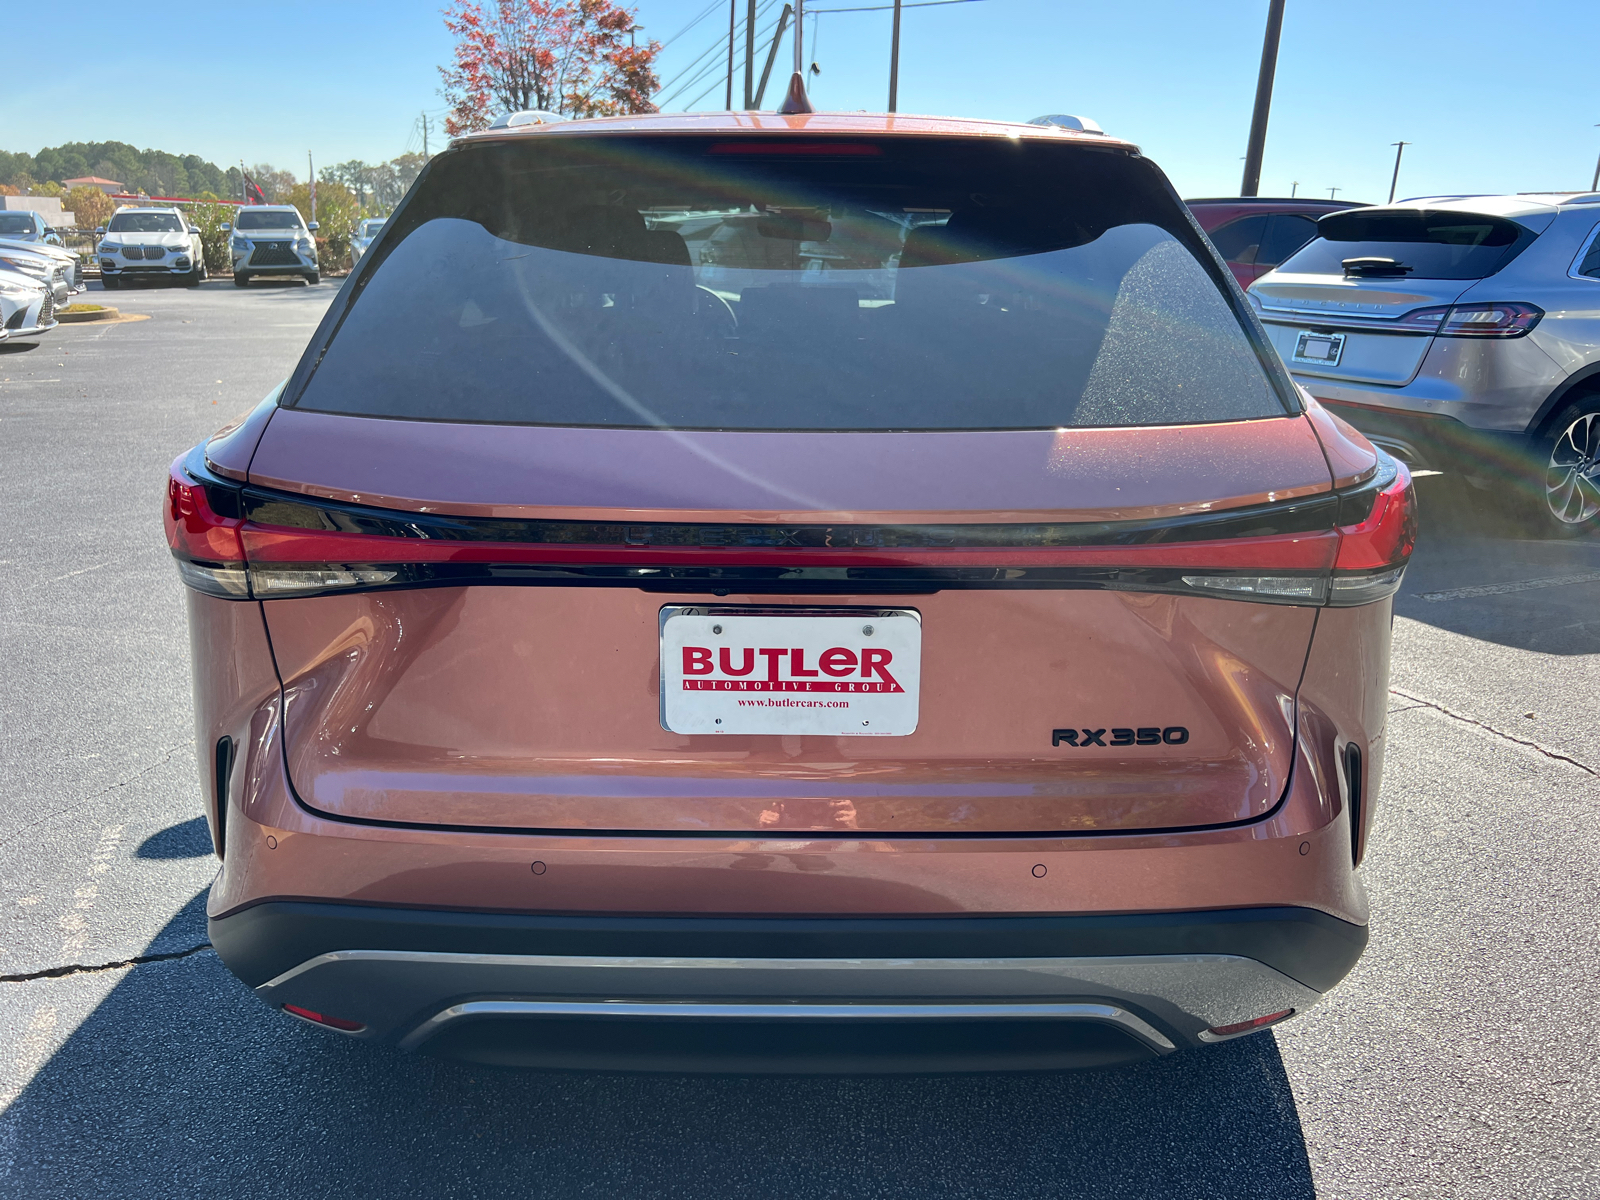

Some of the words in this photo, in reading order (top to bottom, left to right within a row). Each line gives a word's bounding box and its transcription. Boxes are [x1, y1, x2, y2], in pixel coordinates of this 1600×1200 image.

[1276, 297, 1384, 310] LINCOLN
[623, 526, 956, 547] LEXUS
[684, 680, 812, 691] AUTOMOTIVE
[834, 682, 897, 692] GROUP
[737, 698, 849, 709] www.butlercars.com
